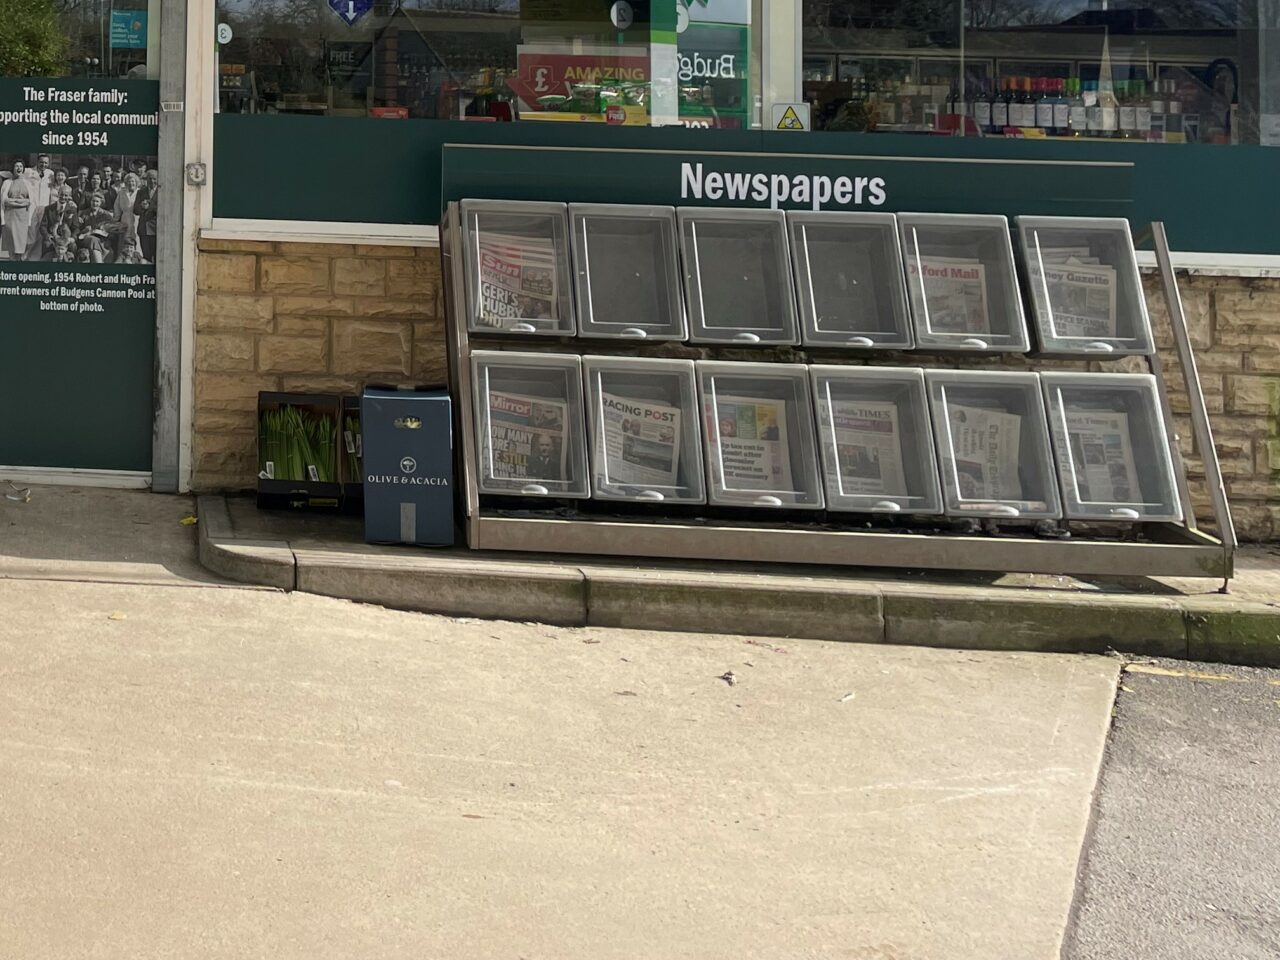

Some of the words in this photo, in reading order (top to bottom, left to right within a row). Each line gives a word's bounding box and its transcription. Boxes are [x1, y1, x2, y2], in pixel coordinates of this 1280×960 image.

[330, 51, 355, 62] FREE
[564, 66, 645, 81] AMAZING
[23, 86, 45, 102] The
[47, 87, 86, 103] Fraser
[88, 88, 128, 106] family:
[49, 109, 70, 124] the
[72, 109, 101, 125] local
[41, 131, 74, 146] since
[77, 131, 108, 146] 1954
[680, 162, 887, 211] Newspapers
[483, 254, 520, 277] Sun
[18, 272, 52, 284] opening,
[54, 272, 74, 282] 1954
[75, 273, 103, 284] Robert
[103, 273, 119, 284] and
[120, 274, 141, 286] Hugh
[950, 268, 980, 279] Mail
[1066, 272, 1110, 286] Gazette
[20, 287, 50, 296] owners
[50, 286, 59, 296] of
[60, 286, 95, 299] Budgens
[96, 288, 126, 298] Cannon
[128, 289, 145, 298] Pool
[146, 290, 155, 299] at
[482, 282, 519, 306] GERI'S
[40, 301, 68, 311] bottom
[70, 301, 78, 311] of
[79, 302, 105, 313] photo.
[482, 296, 525, 319] HUBBY
[490, 395, 531, 414] Mirror
[602, 397, 642, 417] RACING
[644, 409, 676, 422] POST
[856, 408, 891, 419] TIMES
[507, 428, 534, 444] MANY
[501, 452, 528, 465] STILL
[368, 474, 400, 485] OLIVE
[401, 476, 409, 485] &
[410, 476, 449, 486] ACACIA
